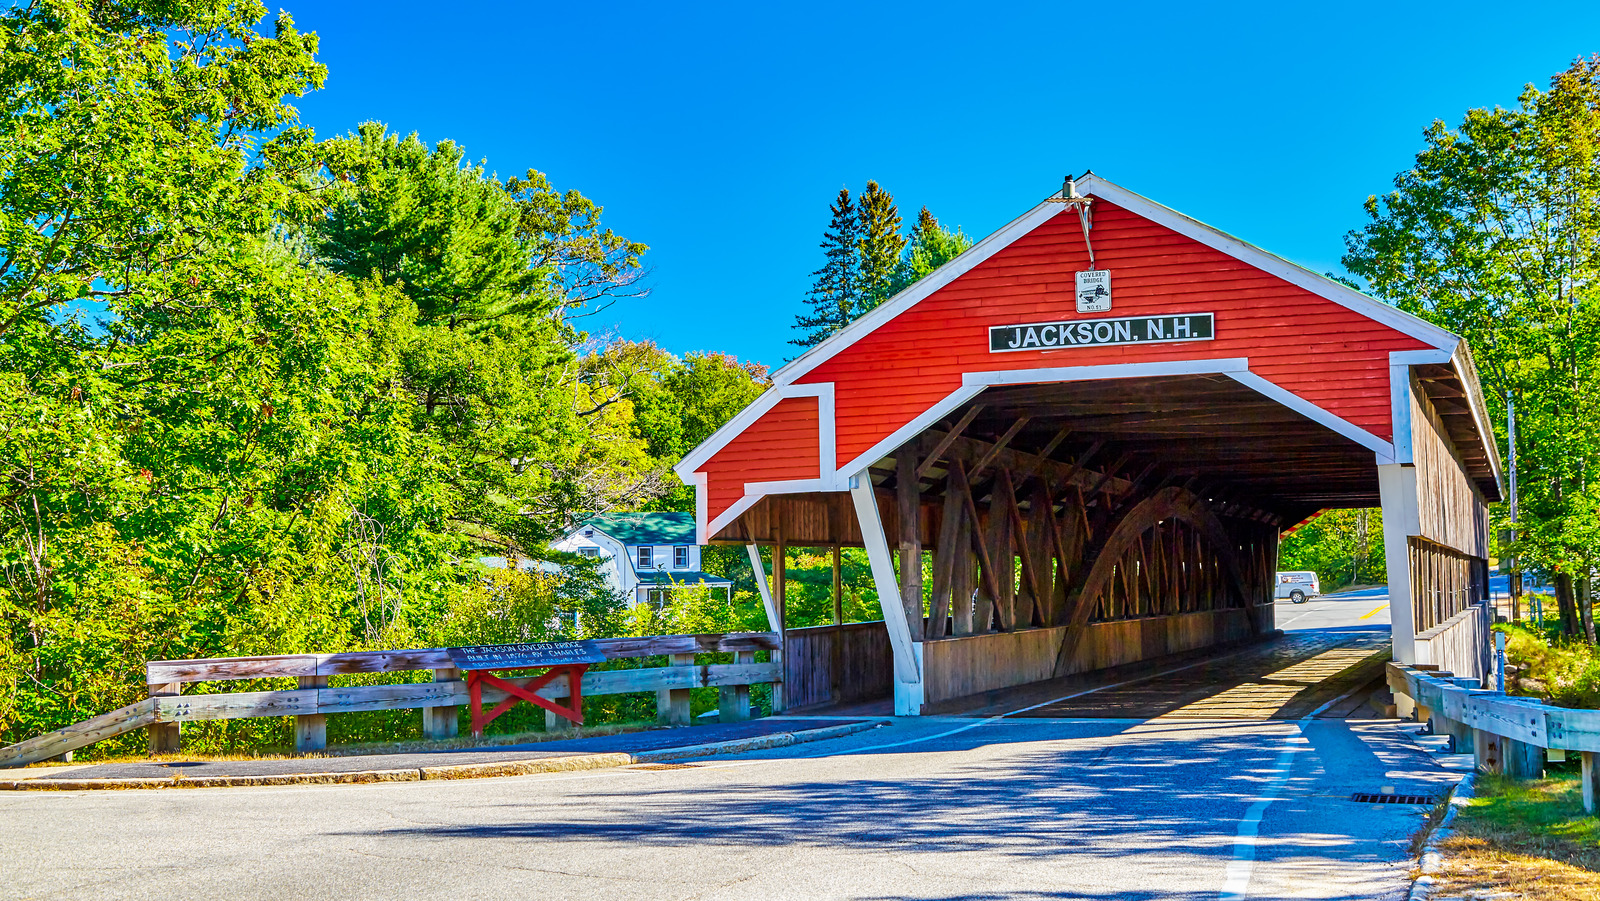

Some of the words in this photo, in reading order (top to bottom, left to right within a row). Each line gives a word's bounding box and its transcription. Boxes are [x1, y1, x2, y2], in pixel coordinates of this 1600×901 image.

[1008, 320, 1139, 349] JACKSON,
[1147, 317, 1198, 340] N.H.
[460, 647, 478, 655] THE
[480, 645, 516, 653] JACKSON
[517, 643, 553, 652] COVERED
[554, 641, 583, 649] BRIDGE
[466, 653, 490, 662] BUILT
[492, 653, 503, 661] IN
[548, 648, 587, 657] CHARLES
